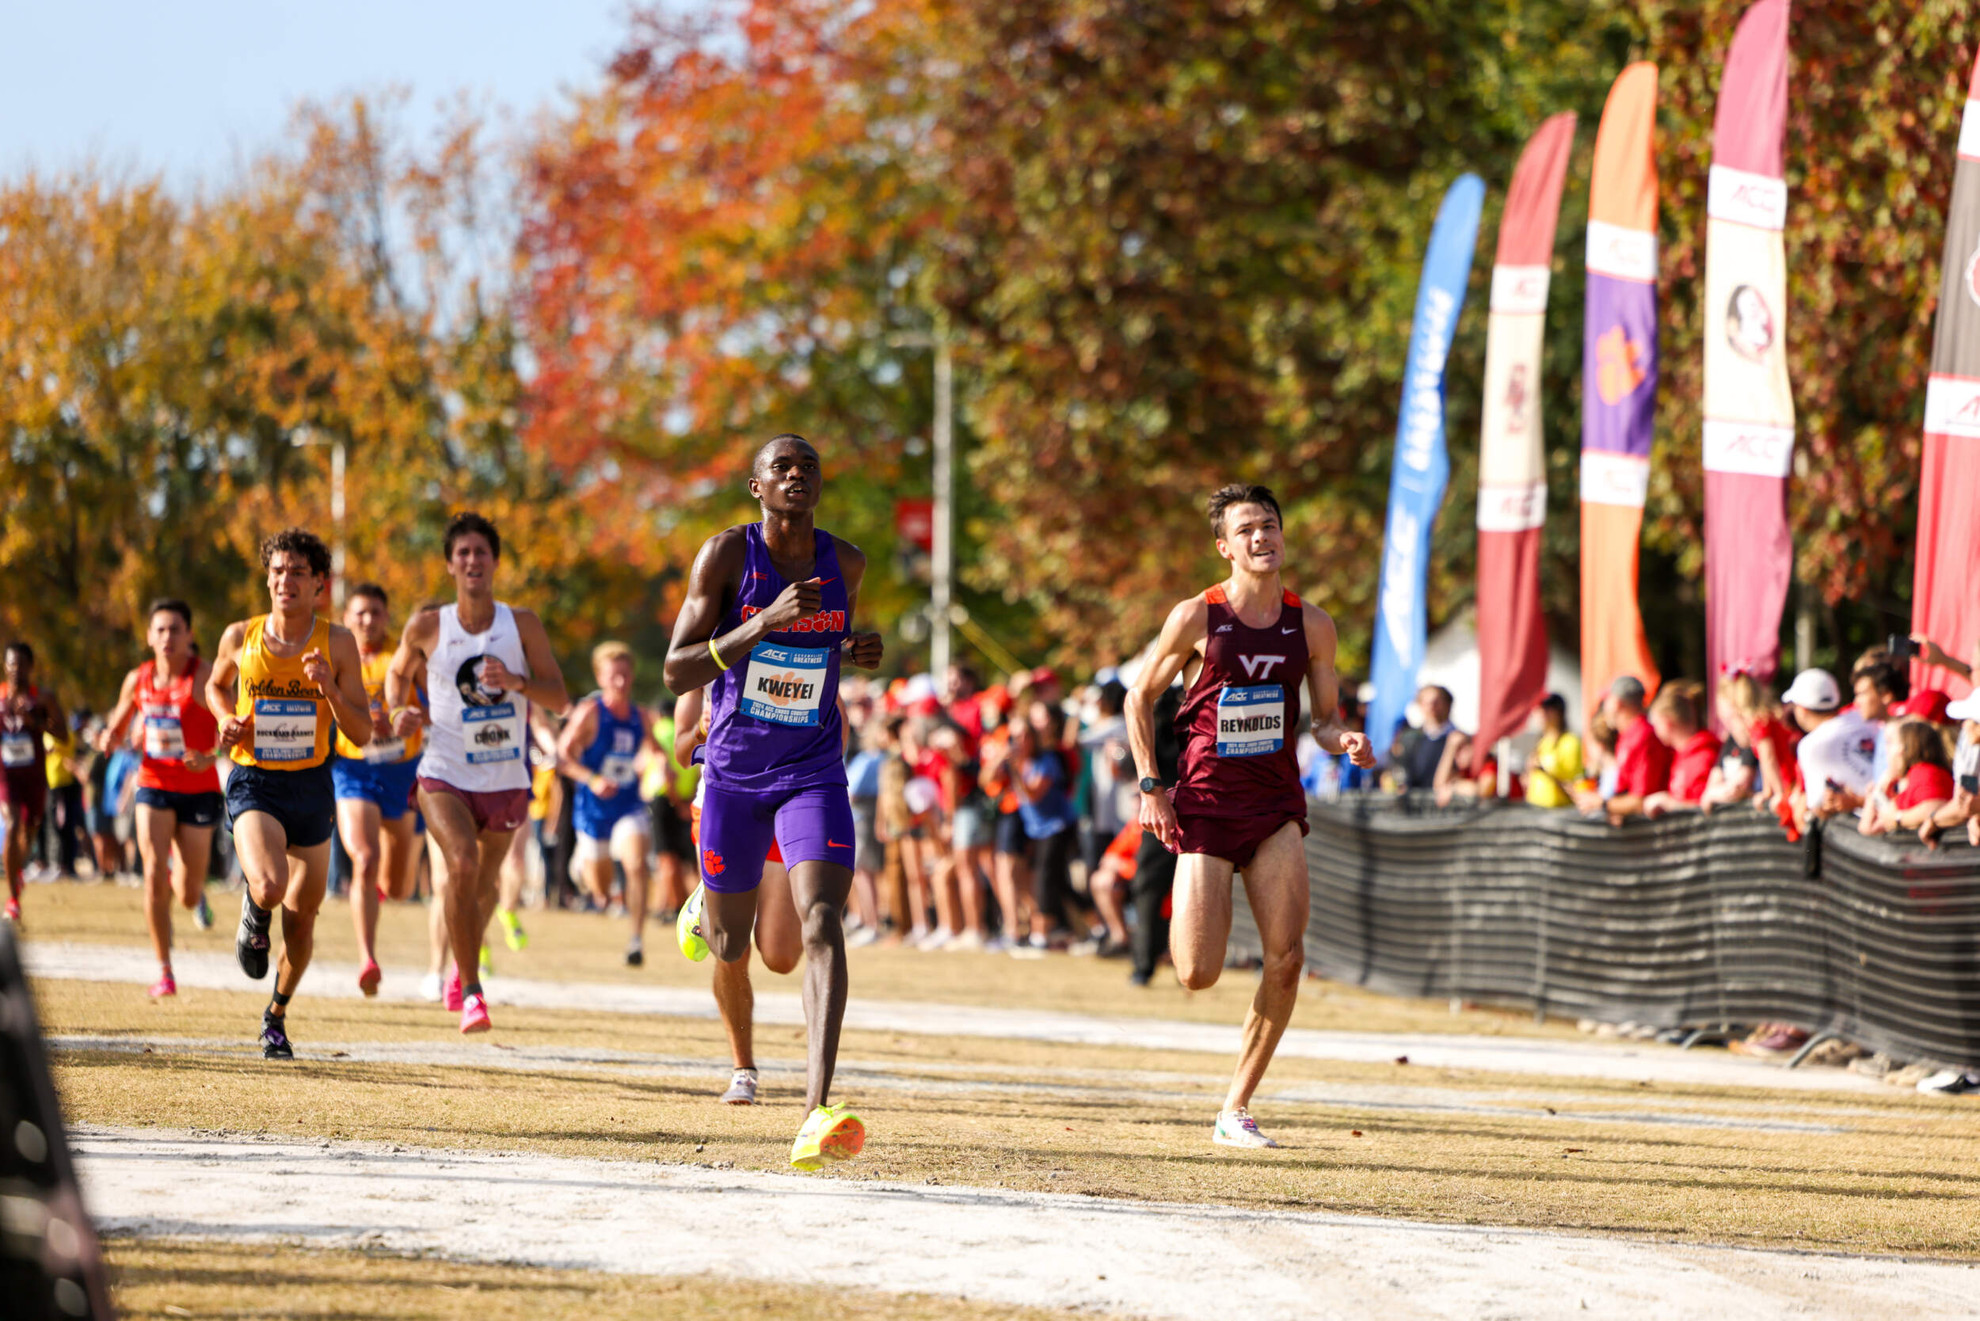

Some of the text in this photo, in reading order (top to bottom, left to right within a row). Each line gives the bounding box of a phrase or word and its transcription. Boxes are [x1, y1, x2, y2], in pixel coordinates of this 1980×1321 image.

[741, 604, 845, 633] CSON
[1215, 624, 1233, 633] ACC
[757, 649, 789, 662] ACC
[1238, 654, 1286, 680] VT
[245, 677, 326, 699] Golden Bear
[757, 676, 814, 699] KWEYEI
[1224, 692, 1248, 702] ACC
[750, 706, 809, 723] CHAMPIONSHIPS
[1221, 716, 1281, 732] REYNOLDS
